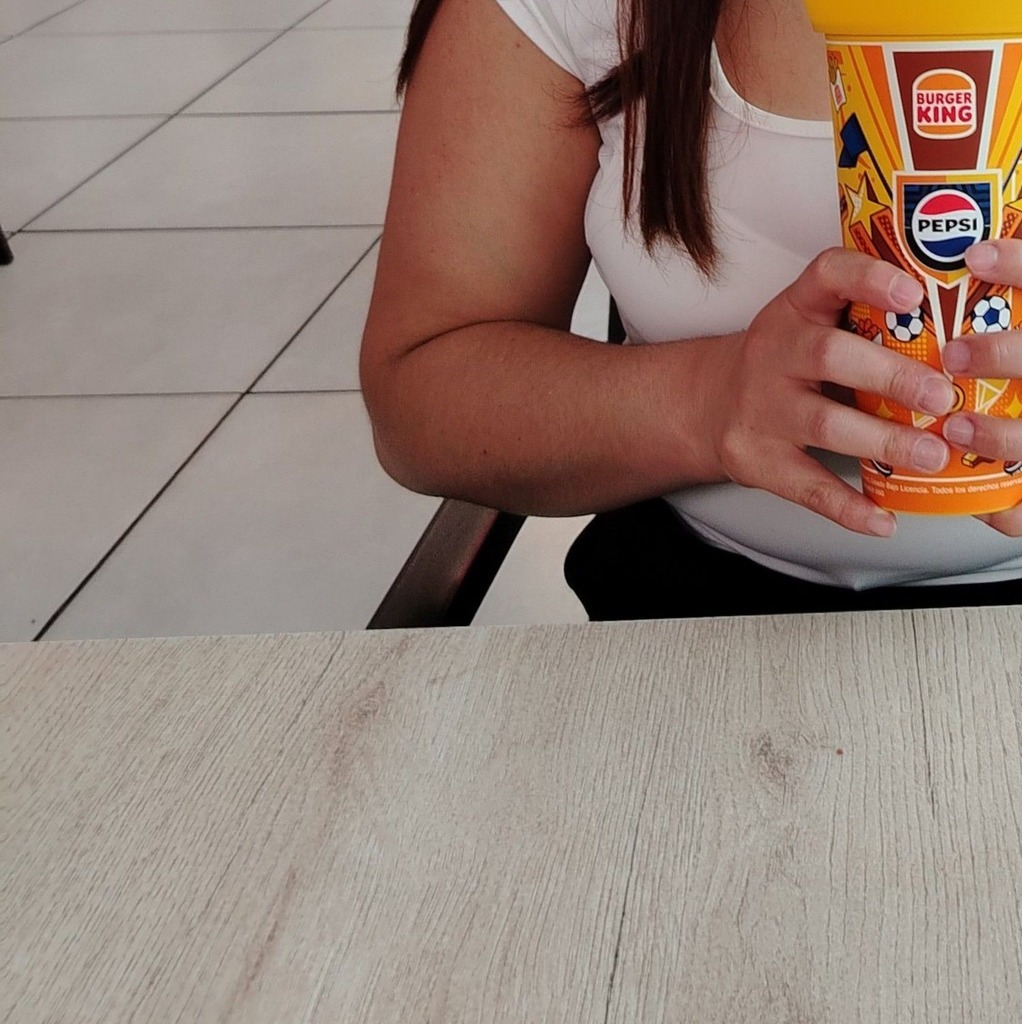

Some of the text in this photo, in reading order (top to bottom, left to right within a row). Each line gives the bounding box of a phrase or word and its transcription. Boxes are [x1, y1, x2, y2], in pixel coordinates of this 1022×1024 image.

[916, 92, 972, 105] BURGER
[916, 106, 972, 123] KING
[918, 218, 978, 233] PEPSI
[932, 486, 953, 495] Todos
[954, 485, 967, 494] los
[967, 483, 1000, 495] derechos
